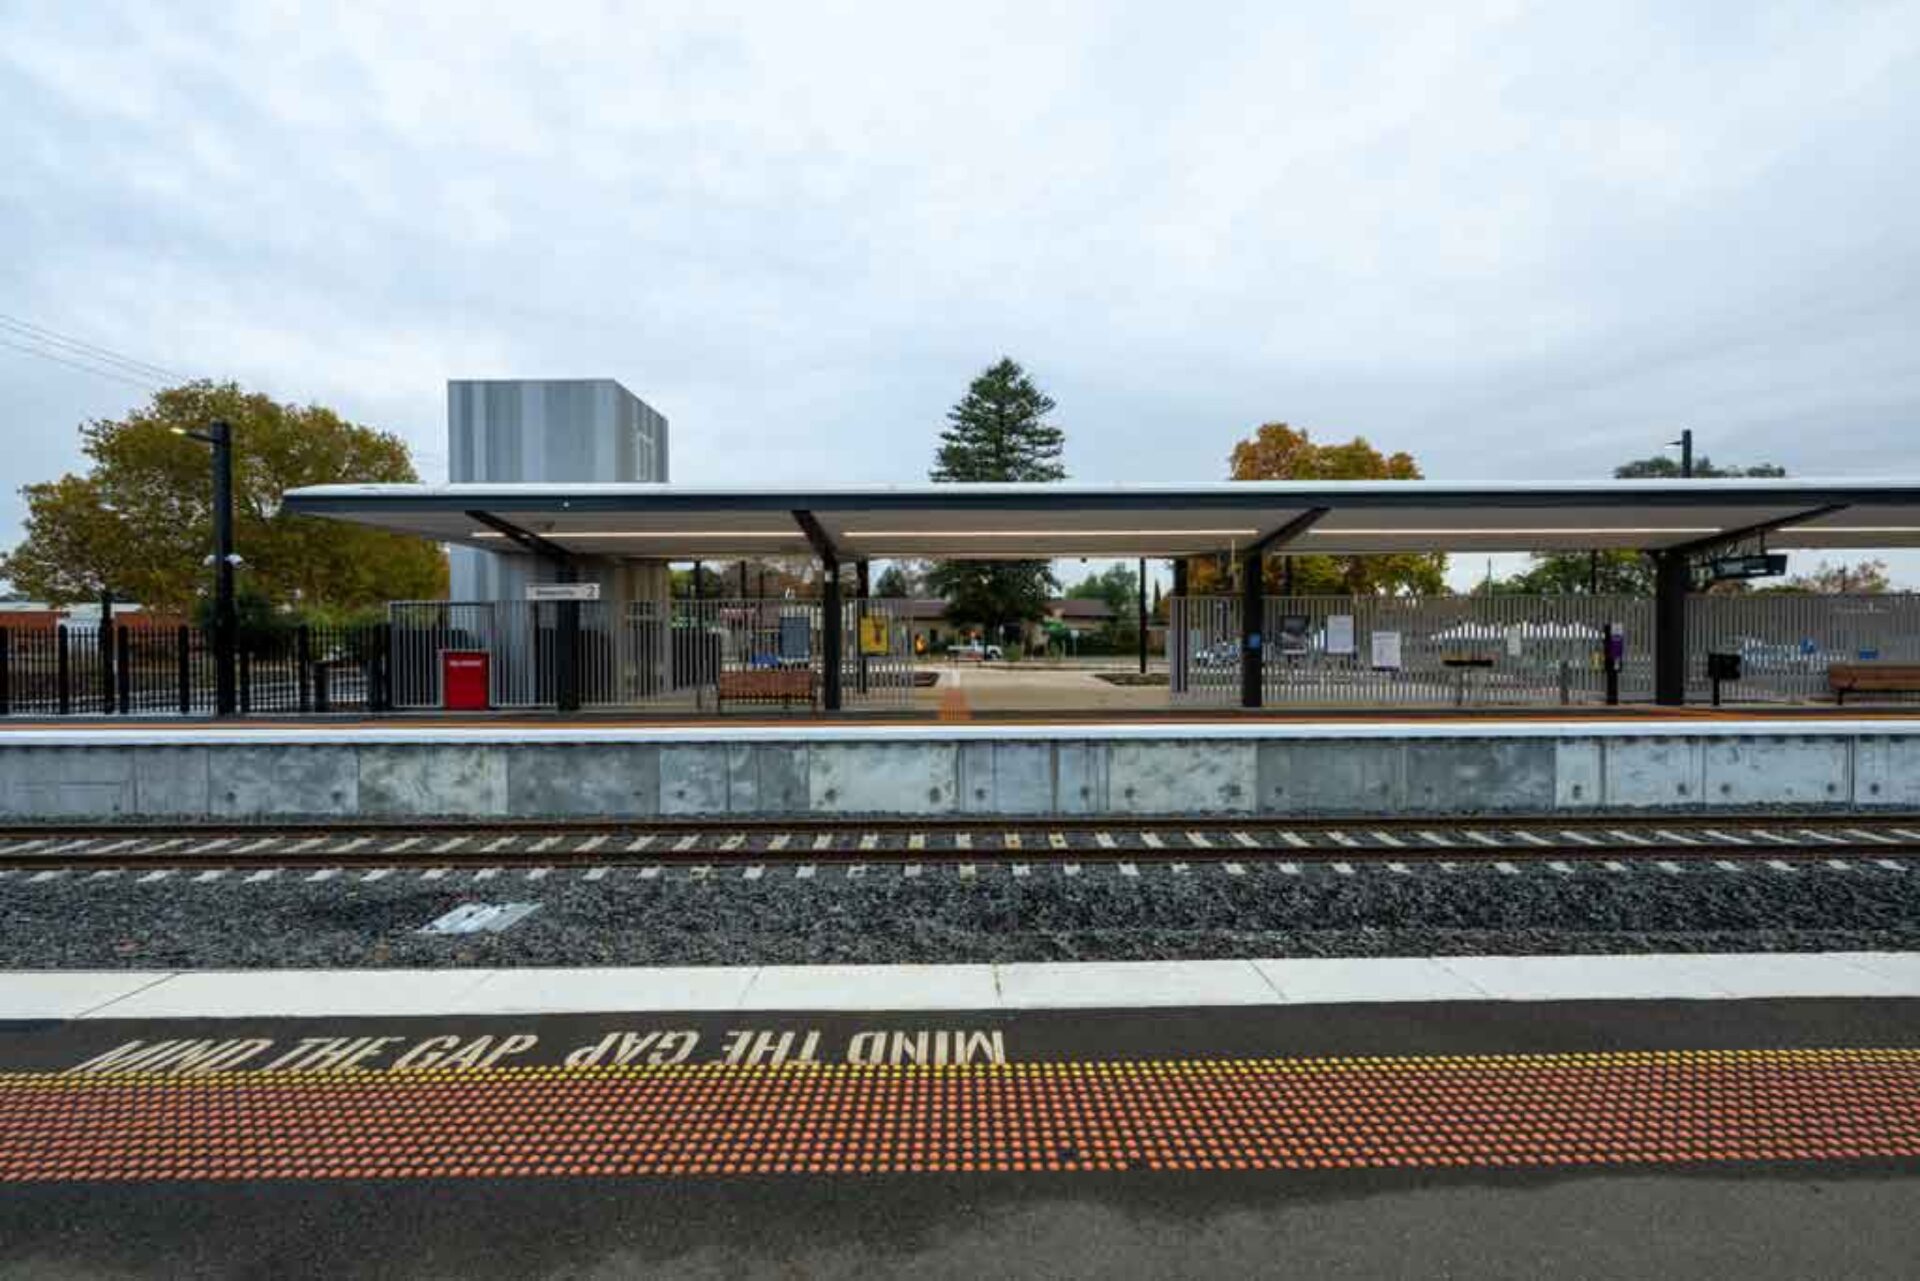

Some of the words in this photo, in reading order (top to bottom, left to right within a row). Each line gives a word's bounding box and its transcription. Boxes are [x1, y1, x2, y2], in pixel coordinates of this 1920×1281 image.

[64, 1038, 274, 1074] MIND
[260, 1036, 406, 1071] THE
[391, 1034, 539, 1069] GAP
[564, 1030, 700, 1066] GAP
[711, 1030, 821, 1066] THE
[847, 1030, 1006, 1065] MIND
